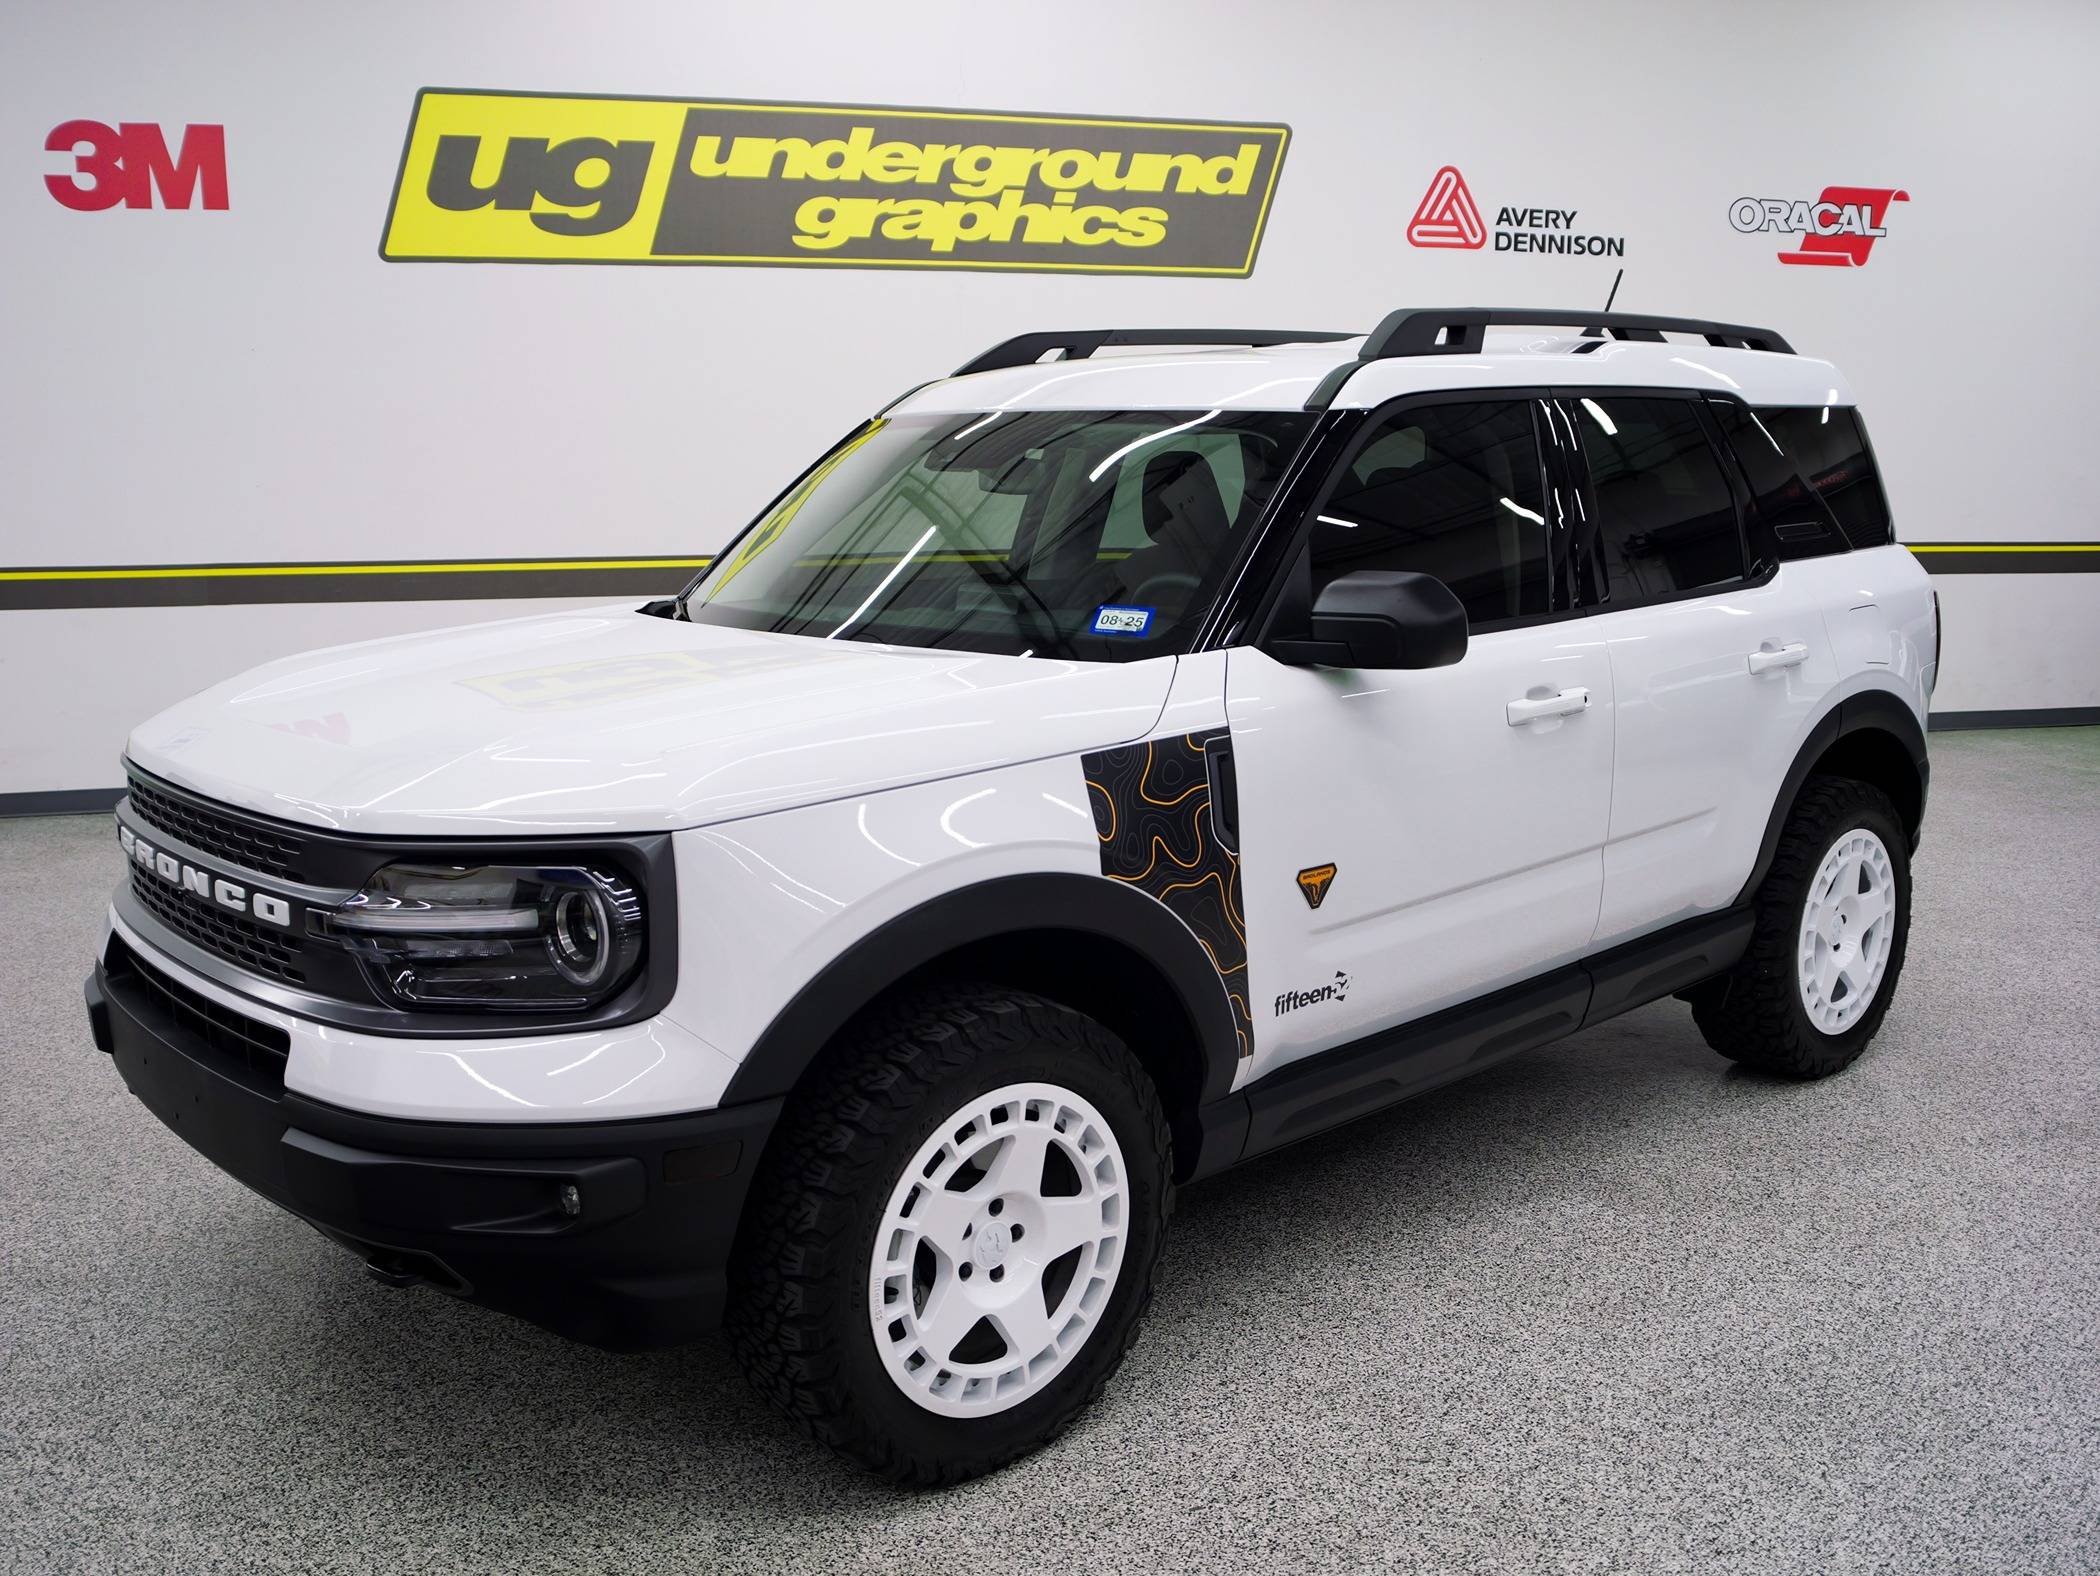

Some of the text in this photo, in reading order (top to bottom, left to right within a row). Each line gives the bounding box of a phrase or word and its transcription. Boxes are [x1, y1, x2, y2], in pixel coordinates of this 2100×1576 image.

[44, 119, 229, 211] 3M
[426, 134, 655, 236] ug
[690, 127, 1262, 198] underground
[792, 191, 1168, 251] graphics
[1494, 232, 1625, 257] DENNISON
[1495, 206, 1577, 230] AVERY
[1729, 197, 1886, 238] ORACAL
[120, 826, 290, 926] BRONCO
